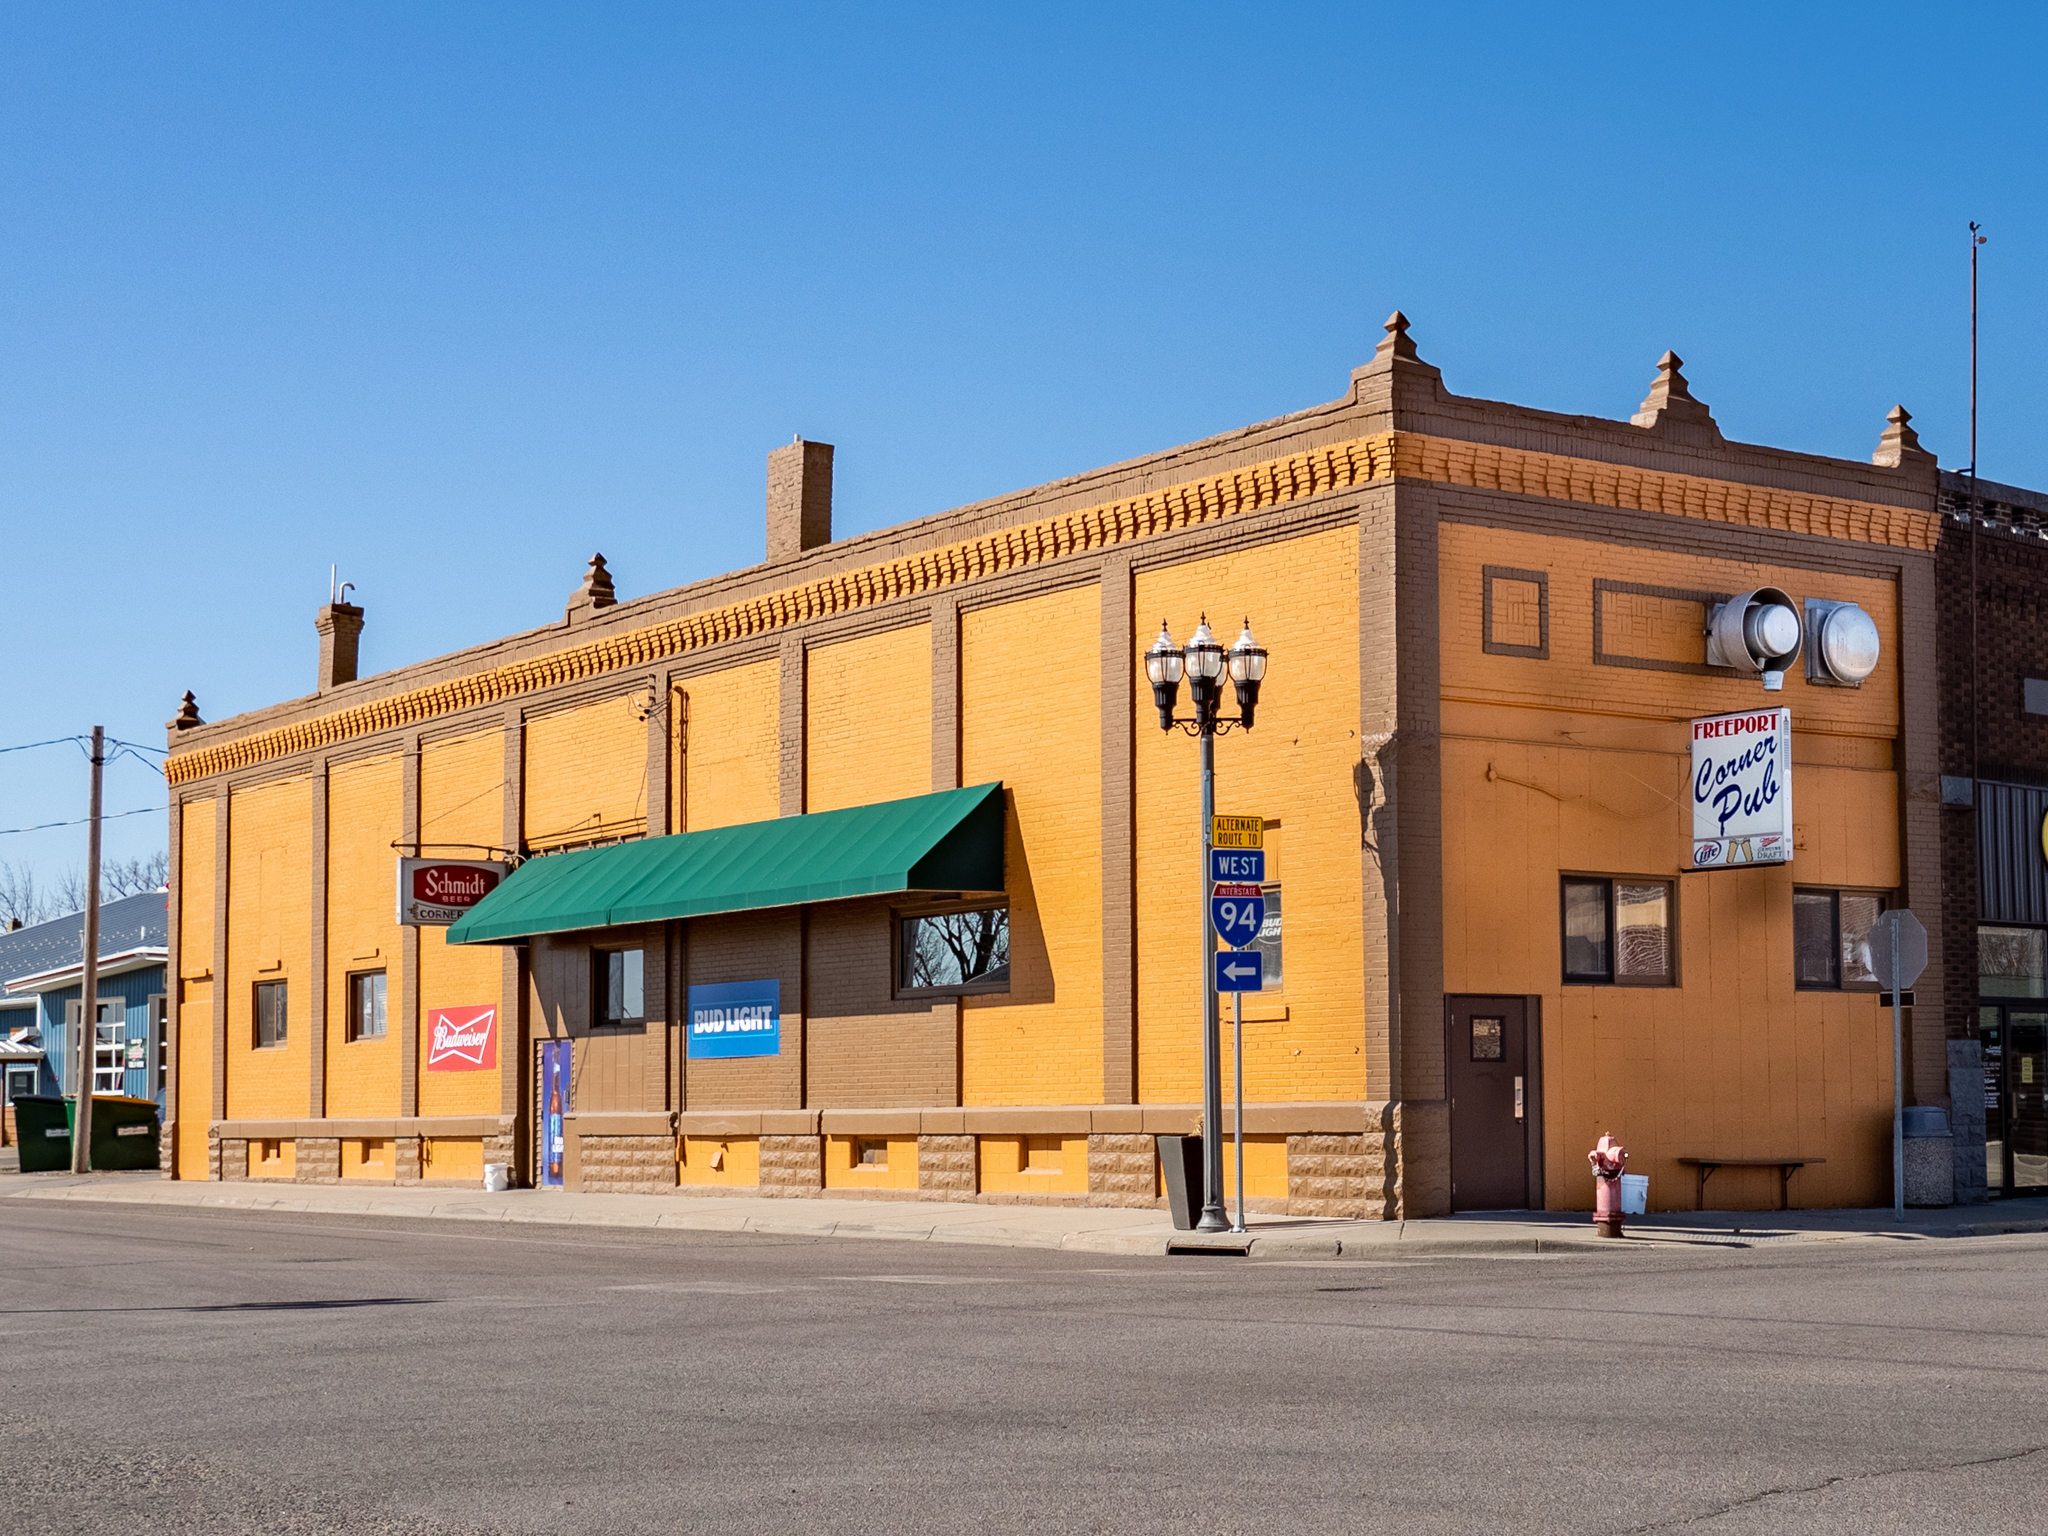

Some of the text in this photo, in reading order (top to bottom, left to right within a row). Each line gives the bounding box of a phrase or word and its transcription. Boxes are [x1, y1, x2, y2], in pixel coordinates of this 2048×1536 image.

[1694, 713, 1779, 740] FREEPORT
[1694, 735, 1778, 803] Corner
[1712, 758, 1781, 837] Pub
[1216, 818, 1259, 832] ALTERNATE
[1217, 832, 1258, 846] ROUTE TO
[1218, 856, 1258, 876] WEST
[425, 868, 486, 897] Schmidt
[1219, 887, 1257, 896] INTERSTATE
[442, 895, 471, 903] BEER
[1220, 902, 1257, 932] 94
[1257, 927, 1282, 937] IGH
[694, 1005, 772, 1034] BUD LIGHT
[434, 1025, 488, 1050] Budweiser
